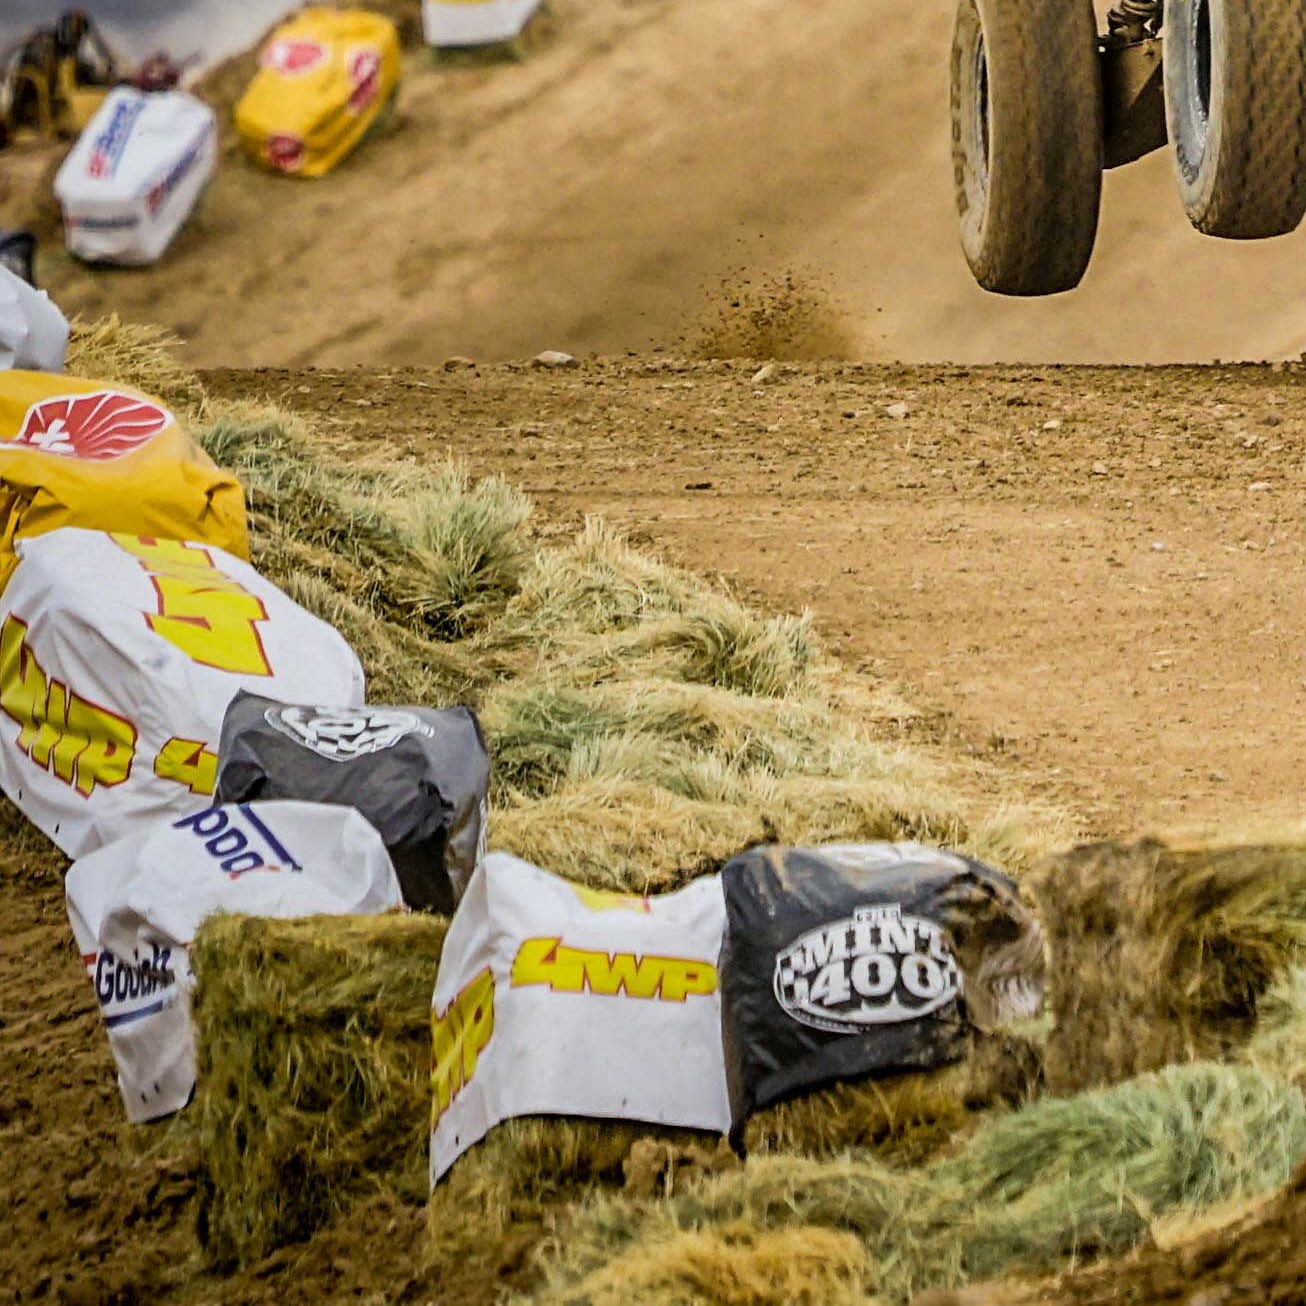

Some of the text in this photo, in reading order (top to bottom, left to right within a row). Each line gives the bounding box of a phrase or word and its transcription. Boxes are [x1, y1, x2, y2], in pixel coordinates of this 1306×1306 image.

[510, 935, 719, 1003] 4WP
[799, 916, 950, 976] MINT
[809, 953, 946, 1007] 400
